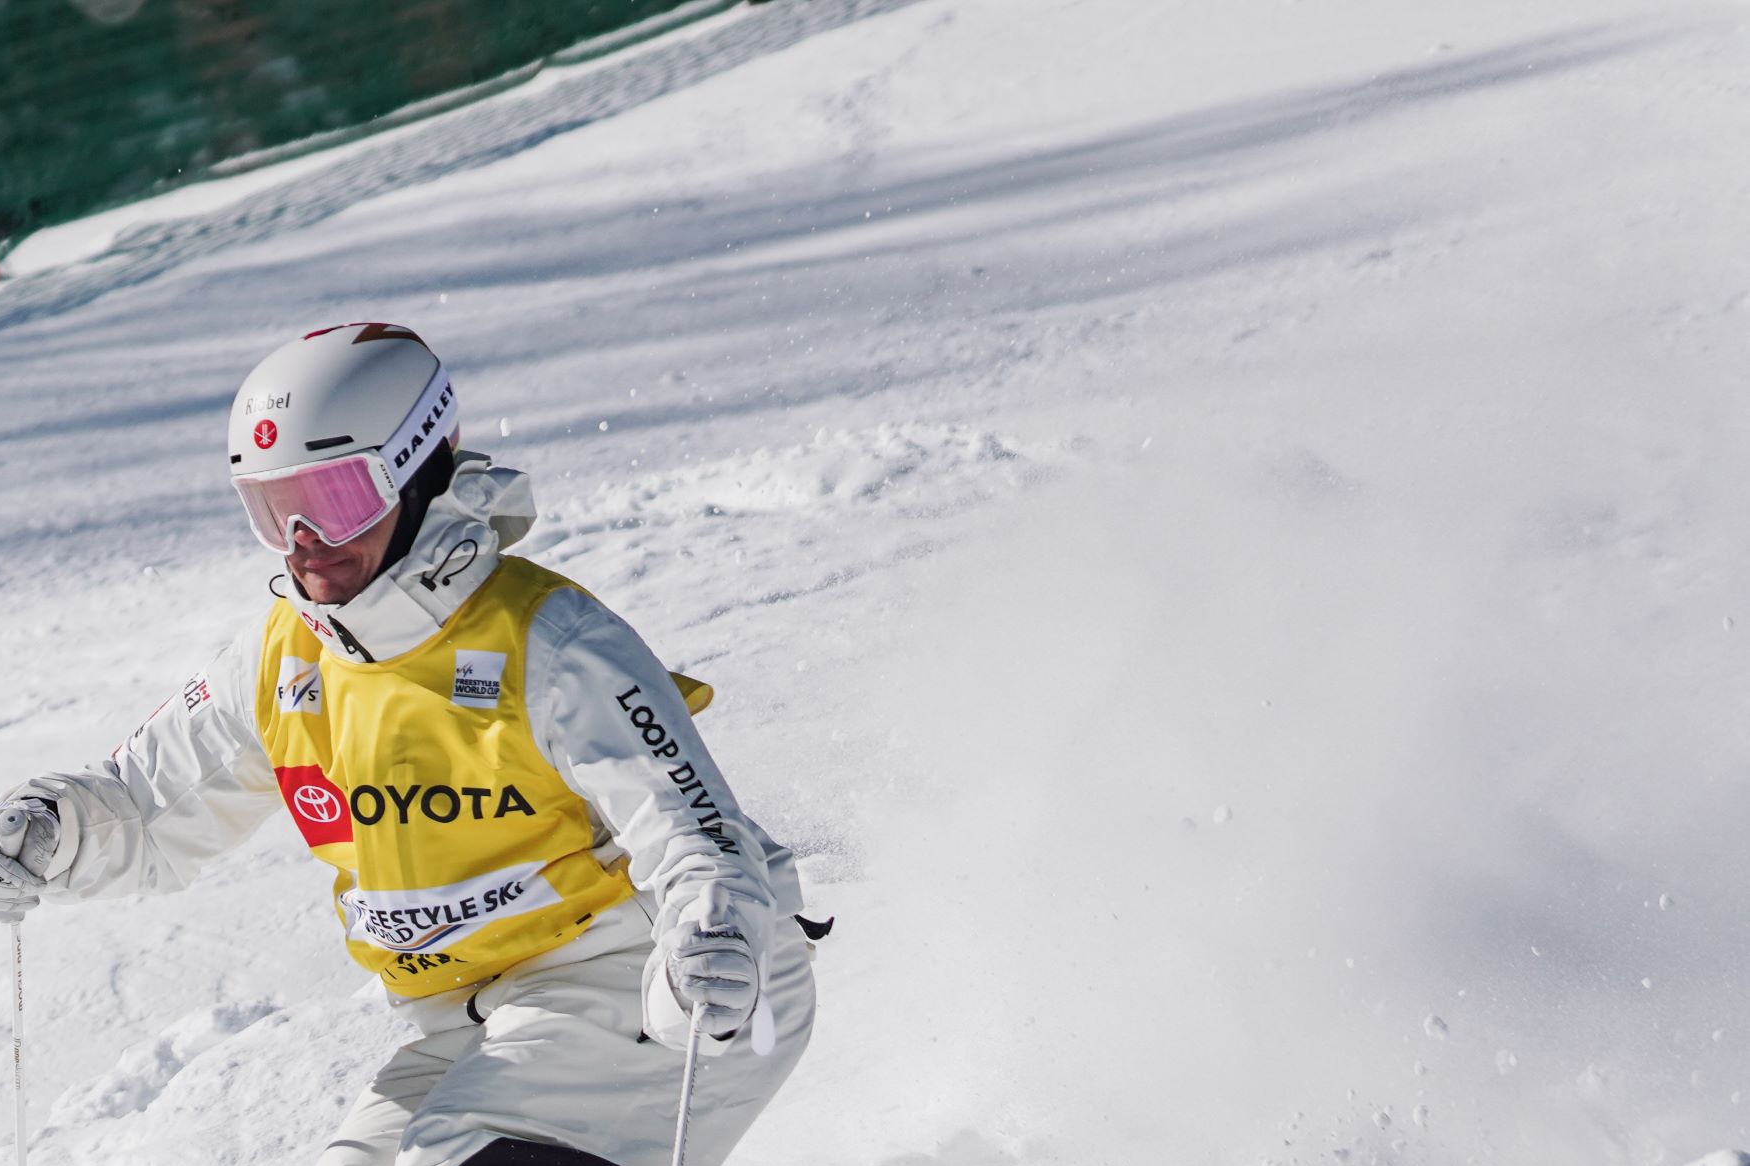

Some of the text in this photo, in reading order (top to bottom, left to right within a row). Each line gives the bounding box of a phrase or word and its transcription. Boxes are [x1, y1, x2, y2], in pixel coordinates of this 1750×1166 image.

[393, 382, 453, 469] OAKLEY
[277, 684, 319, 702] FIS
[454, 685, 487, 695] WORLD
[616, 684, 679, 759] LOOP
[350, 784, 537, 826] OYOTA
